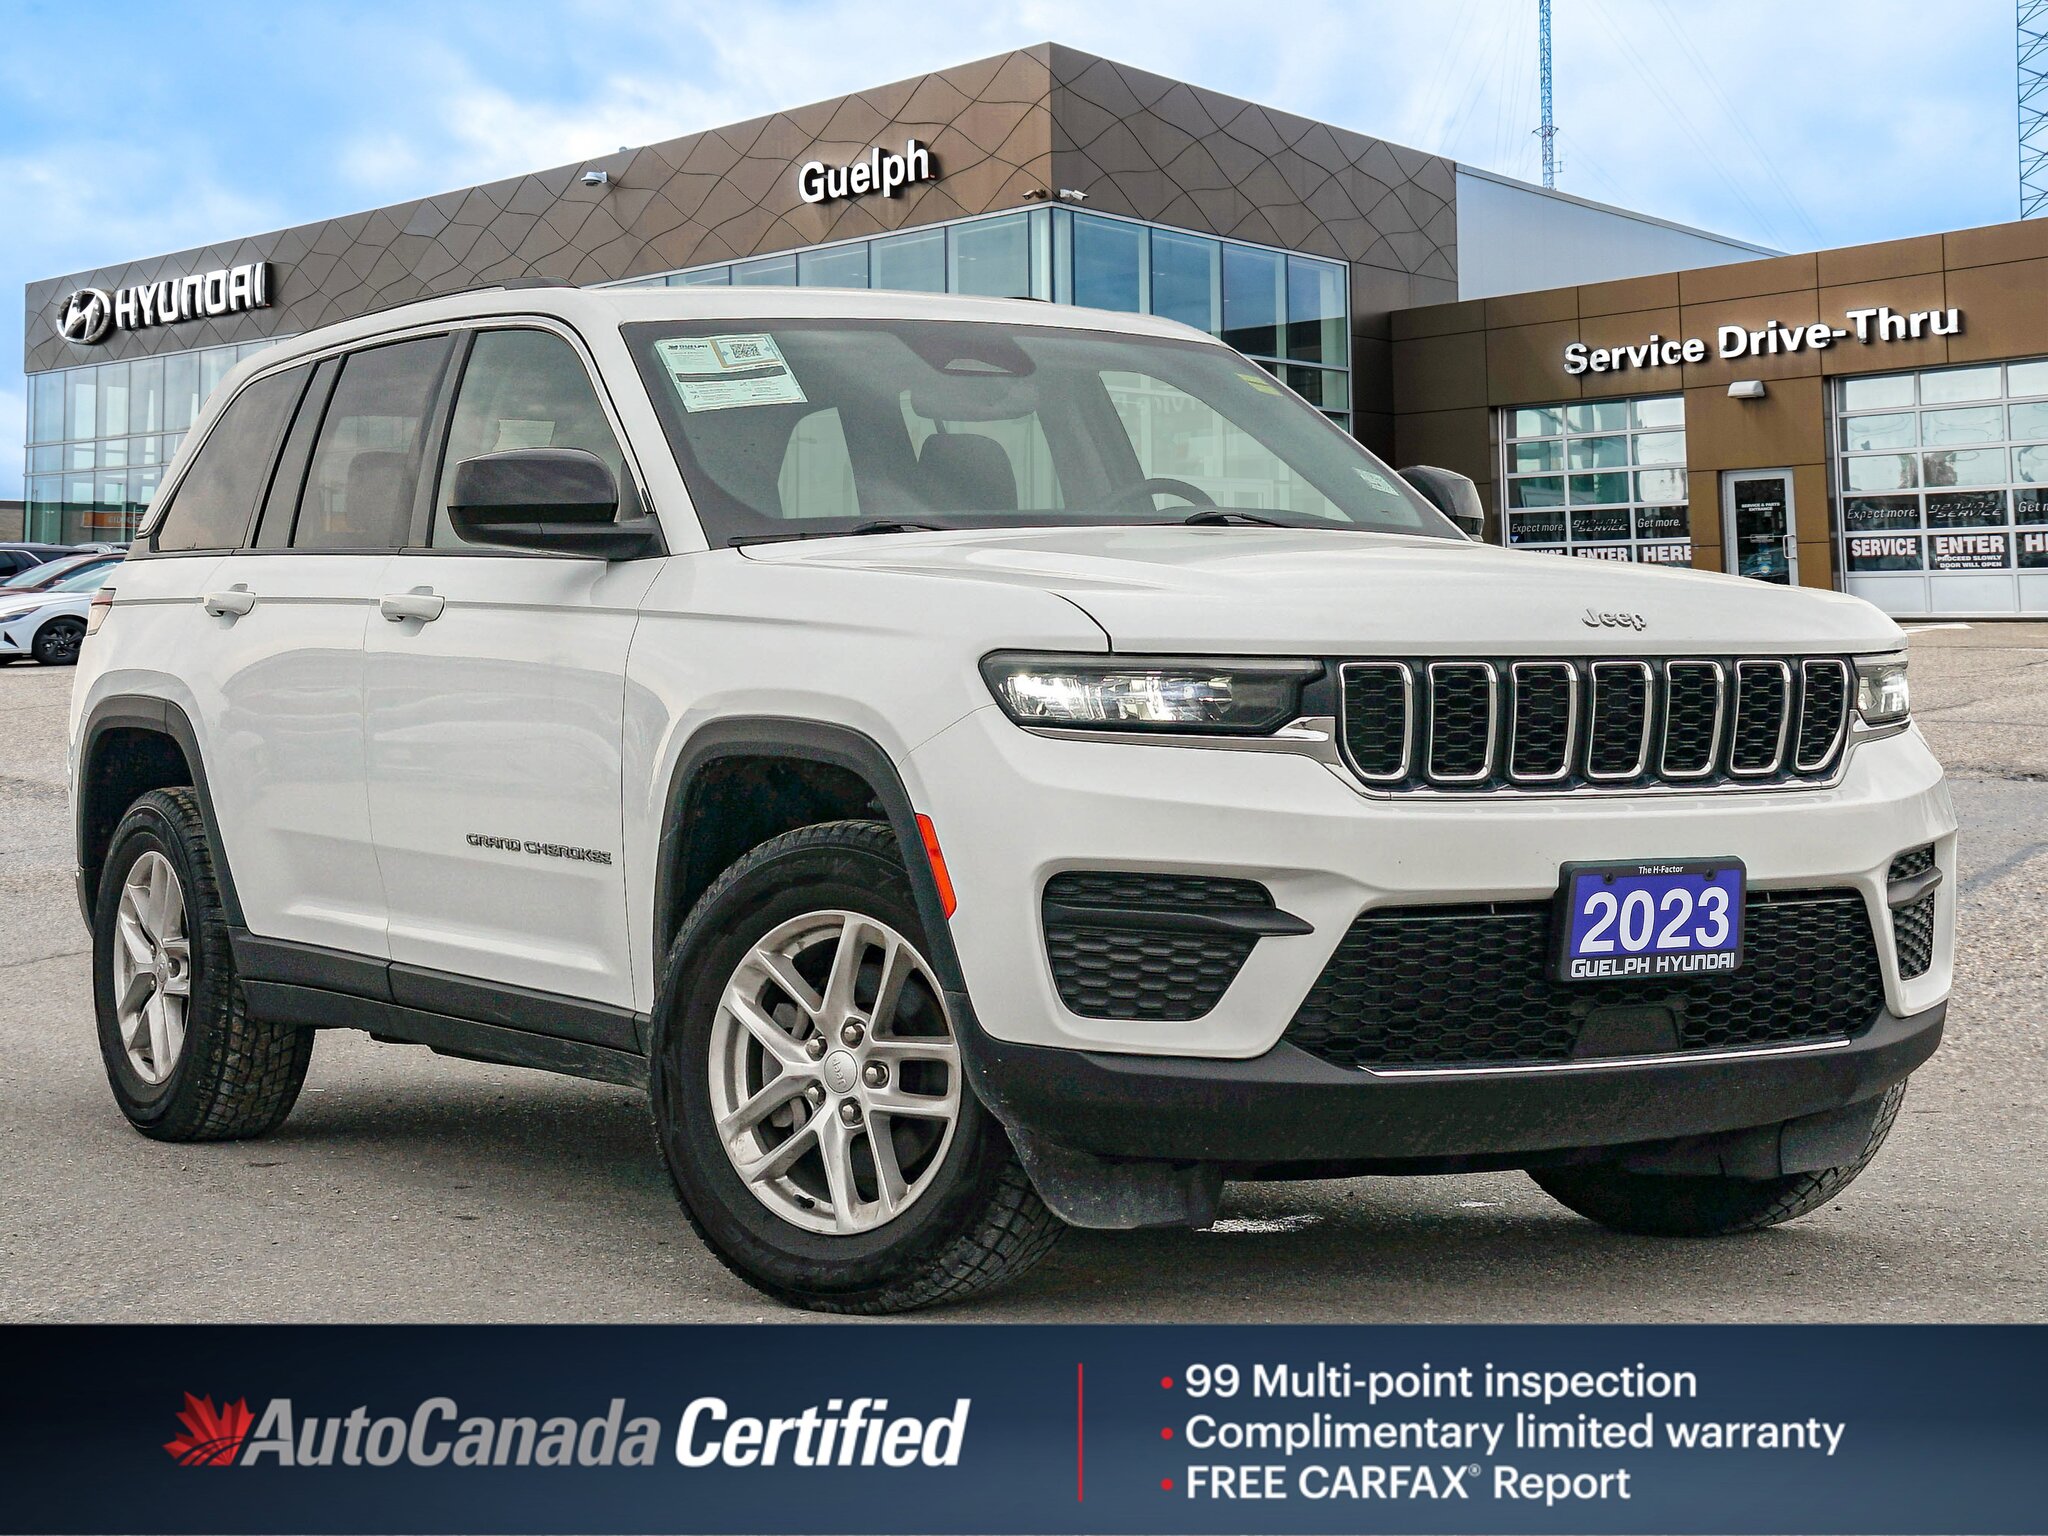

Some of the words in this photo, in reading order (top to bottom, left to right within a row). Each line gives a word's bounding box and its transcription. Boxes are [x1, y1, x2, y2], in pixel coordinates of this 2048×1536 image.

[798, 139, 930, 203] Guelph
[115, 262, 271, 331] HYUNDAI
[1563, 334, 1705, 375] Service
[1717, 307, 1961, 360] Drive-Thru
[1637, 517, 1653, 529] Get
[1655, 518, 1681, 527] more.
[1847, 508, 1884, 520] Expect
[1887, 508, 1918, 518] more.
[1512, 523, 1540, 534] Expect
[1541, 523, 1565, 532] more.
[1851, 537, 1917, 557] SERVICE
[1935, 535, 2005, 555] ENTER
[1581, 608, 1648, 632] Jeep
[466, 833, 521, 852] GRAND
[523, 840, 612, 865] CHEROKEE
[1638, 866, 1652, 874] The
[1653, 865, 1684, 874] H-Factor
[1580, 887, 1729, 953] 2023
[1570, 956, 1651, 979] GUELPH
[1656, 952, 1735, 974] HYUNDAI
